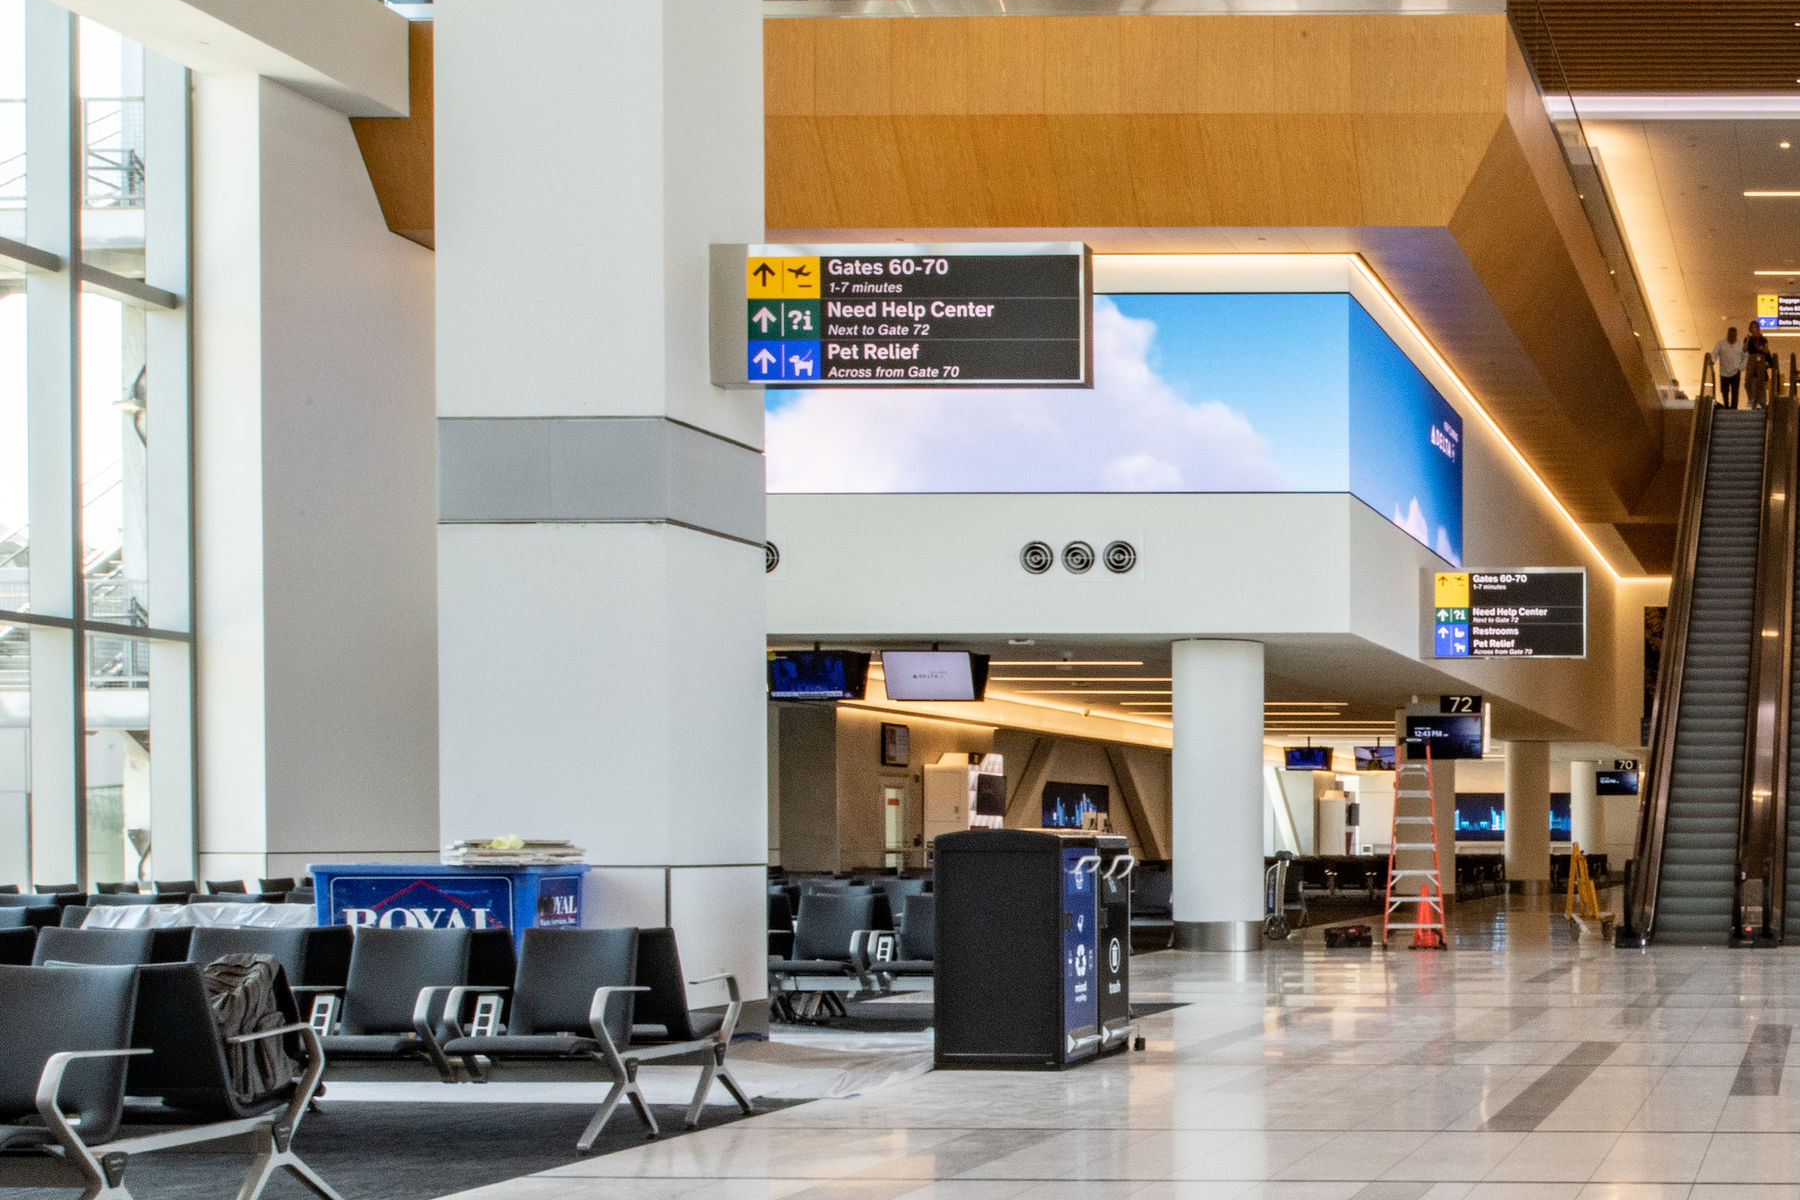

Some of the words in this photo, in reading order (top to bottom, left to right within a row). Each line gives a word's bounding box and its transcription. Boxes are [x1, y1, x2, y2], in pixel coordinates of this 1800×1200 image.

[828, 258, 884, 276] Gates
[888, 258, 949, 276] 60-70
[830, 281, 850, 293] 1-7
[851, 281, 903, 293] minutes
[827, 301, 877, 318] Need
[882, 301, 927, 321] Help
[930, 300, 995, 318] Center
[828, 324, 859, 336] Next
[862, 324, 875, 336] to
[877, 323, 910, 336] Gate
[913, 323, 930, 336] 72
[828, 343, 860, 360] Pet
[864, 343, 920, 360] Relief
[827, 366, 872, 378] Across
[875, 366, 905, 378] from
[907, 365, 940, 378] Gate
[942, 365, 960, 378] 70
[1472, 574, 1499, 584] Gates
[1499, 573, 1528, 584] 60-70
[1482, 583, 1507, 591] minutes
[1472, 607, 1496, 617] Need
[1496, 607, 1518, 618] Help
[1517, 606, 1548, 617] Center
[1472, 616, 1488, 624] Next
[1494, 616, 1510, 624] Gate
[1472, 626, 1520, 636] Restrooms
[1472, 638, 1489, 648] Pet
[1488, 638, 1516, 648] Relief
[1449, 696, 1473, 713] 72
[1618, 760, 1634, 770] 70
